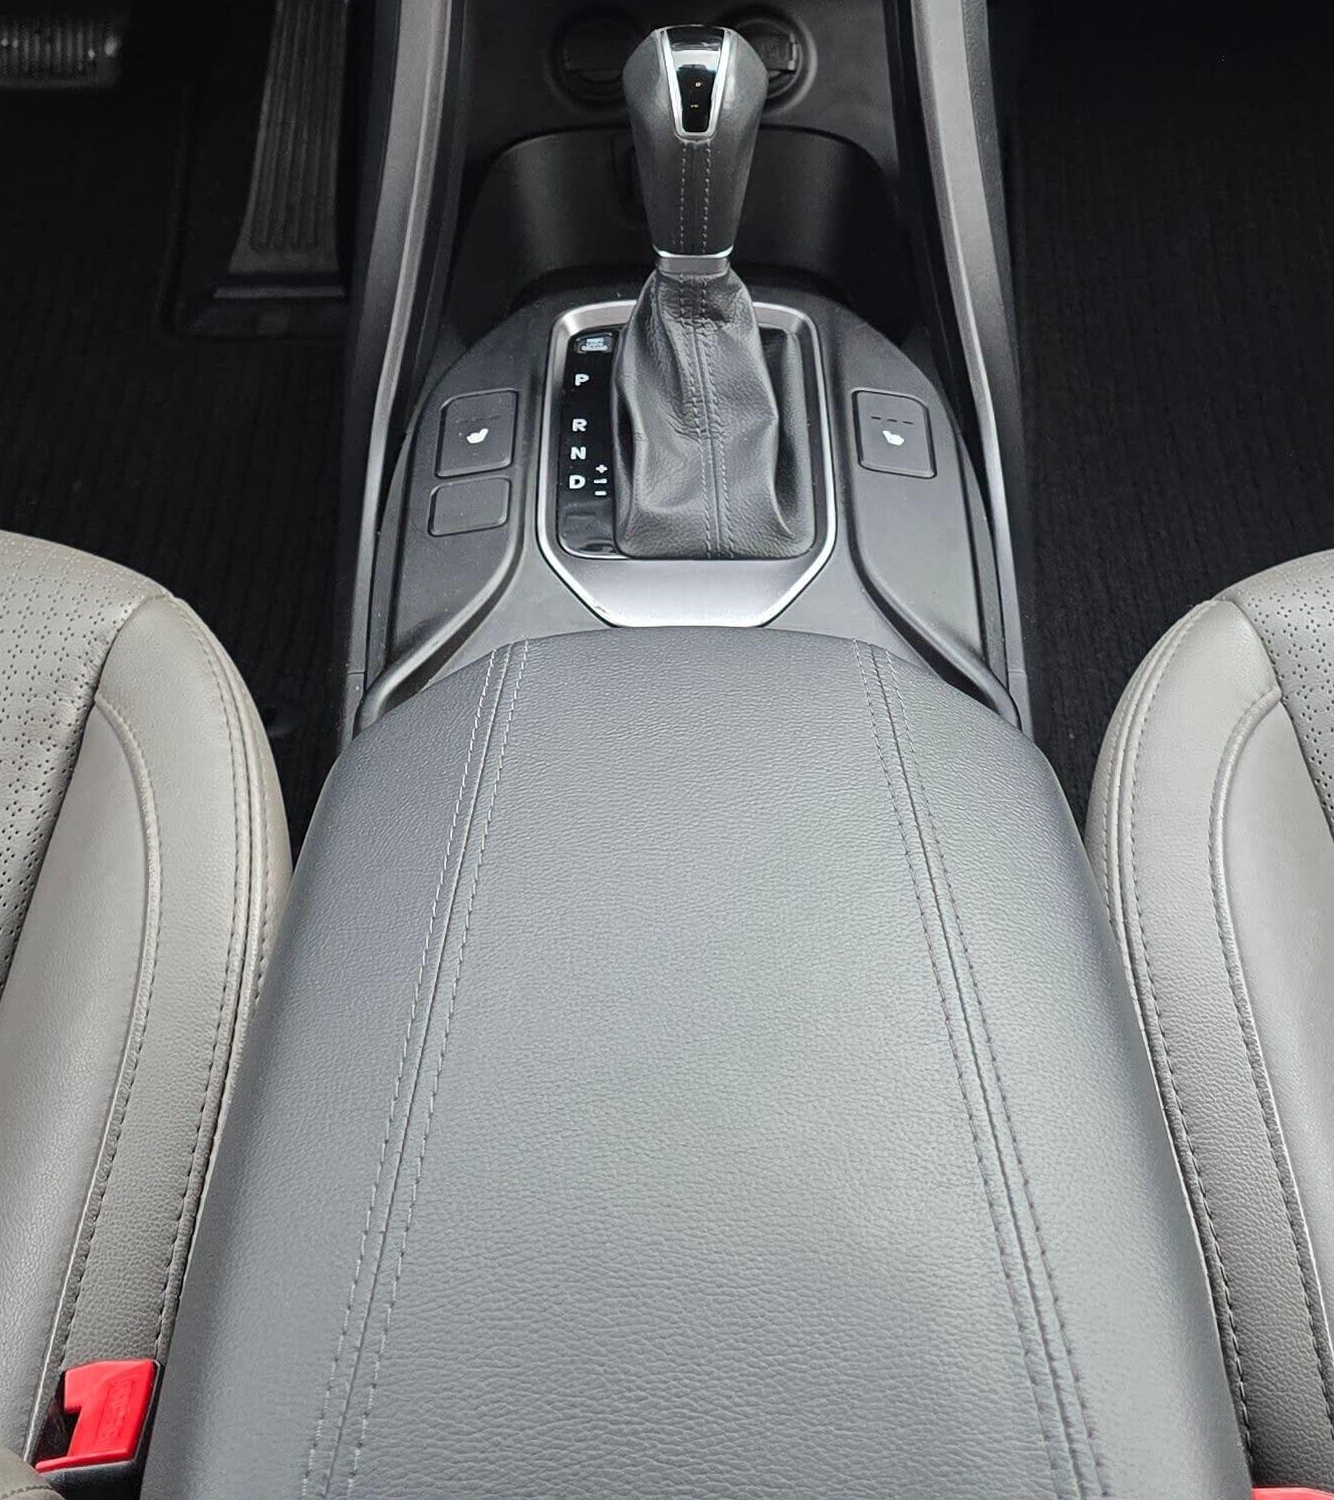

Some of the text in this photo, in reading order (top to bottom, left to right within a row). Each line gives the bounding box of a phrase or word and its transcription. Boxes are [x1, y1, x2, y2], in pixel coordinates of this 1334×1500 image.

[574, 373, 590, 386] P
[572, 418, 588, 432] R
[570, 446, 587, 460] N
[569, 474, 586, 490] D
